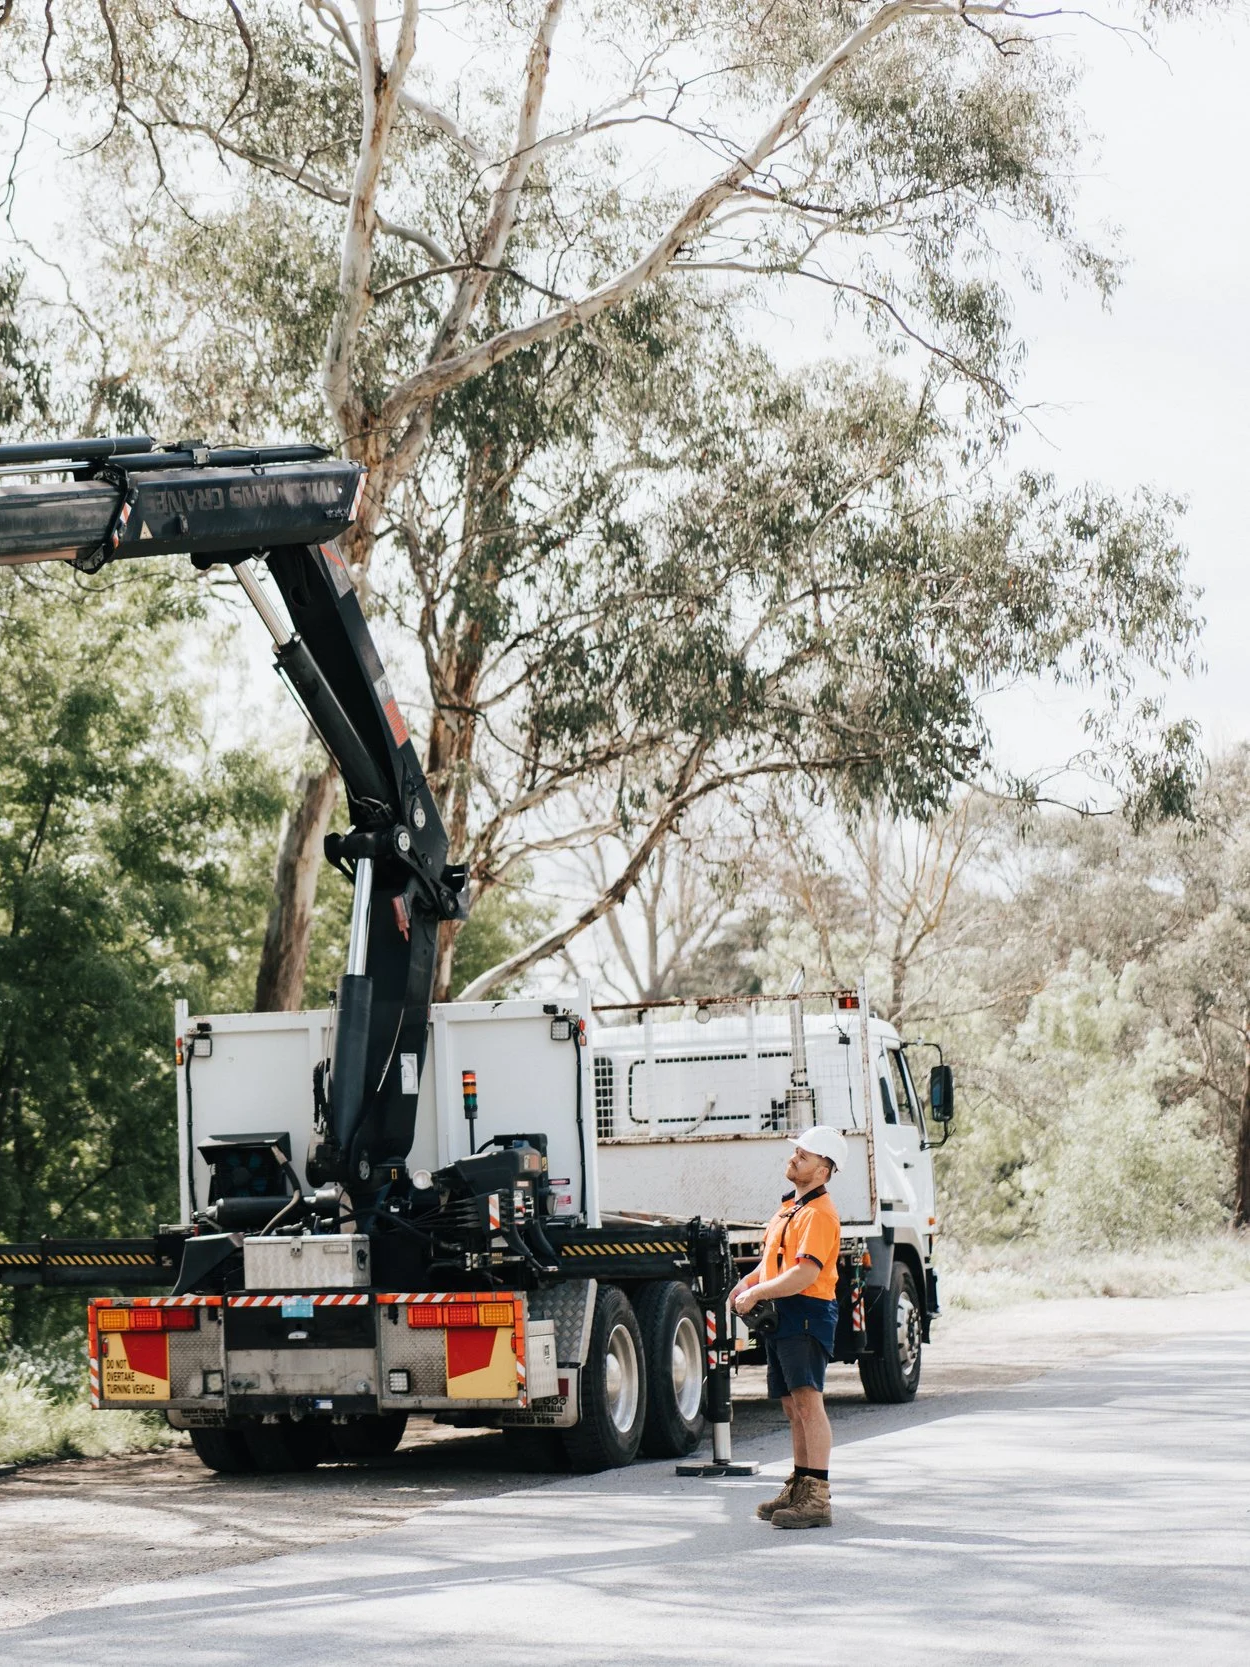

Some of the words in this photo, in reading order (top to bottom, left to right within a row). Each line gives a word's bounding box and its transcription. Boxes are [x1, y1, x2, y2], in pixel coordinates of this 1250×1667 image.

[106, 1359, 114, 1369] DO
[116, 1359, 126, 1369] NOT
[106, 1371, 135, 1381] OVERTAKE
[106, 1384, 130, 1394] TURNING
[132, 1384, 155, 1394] VEHICLE
